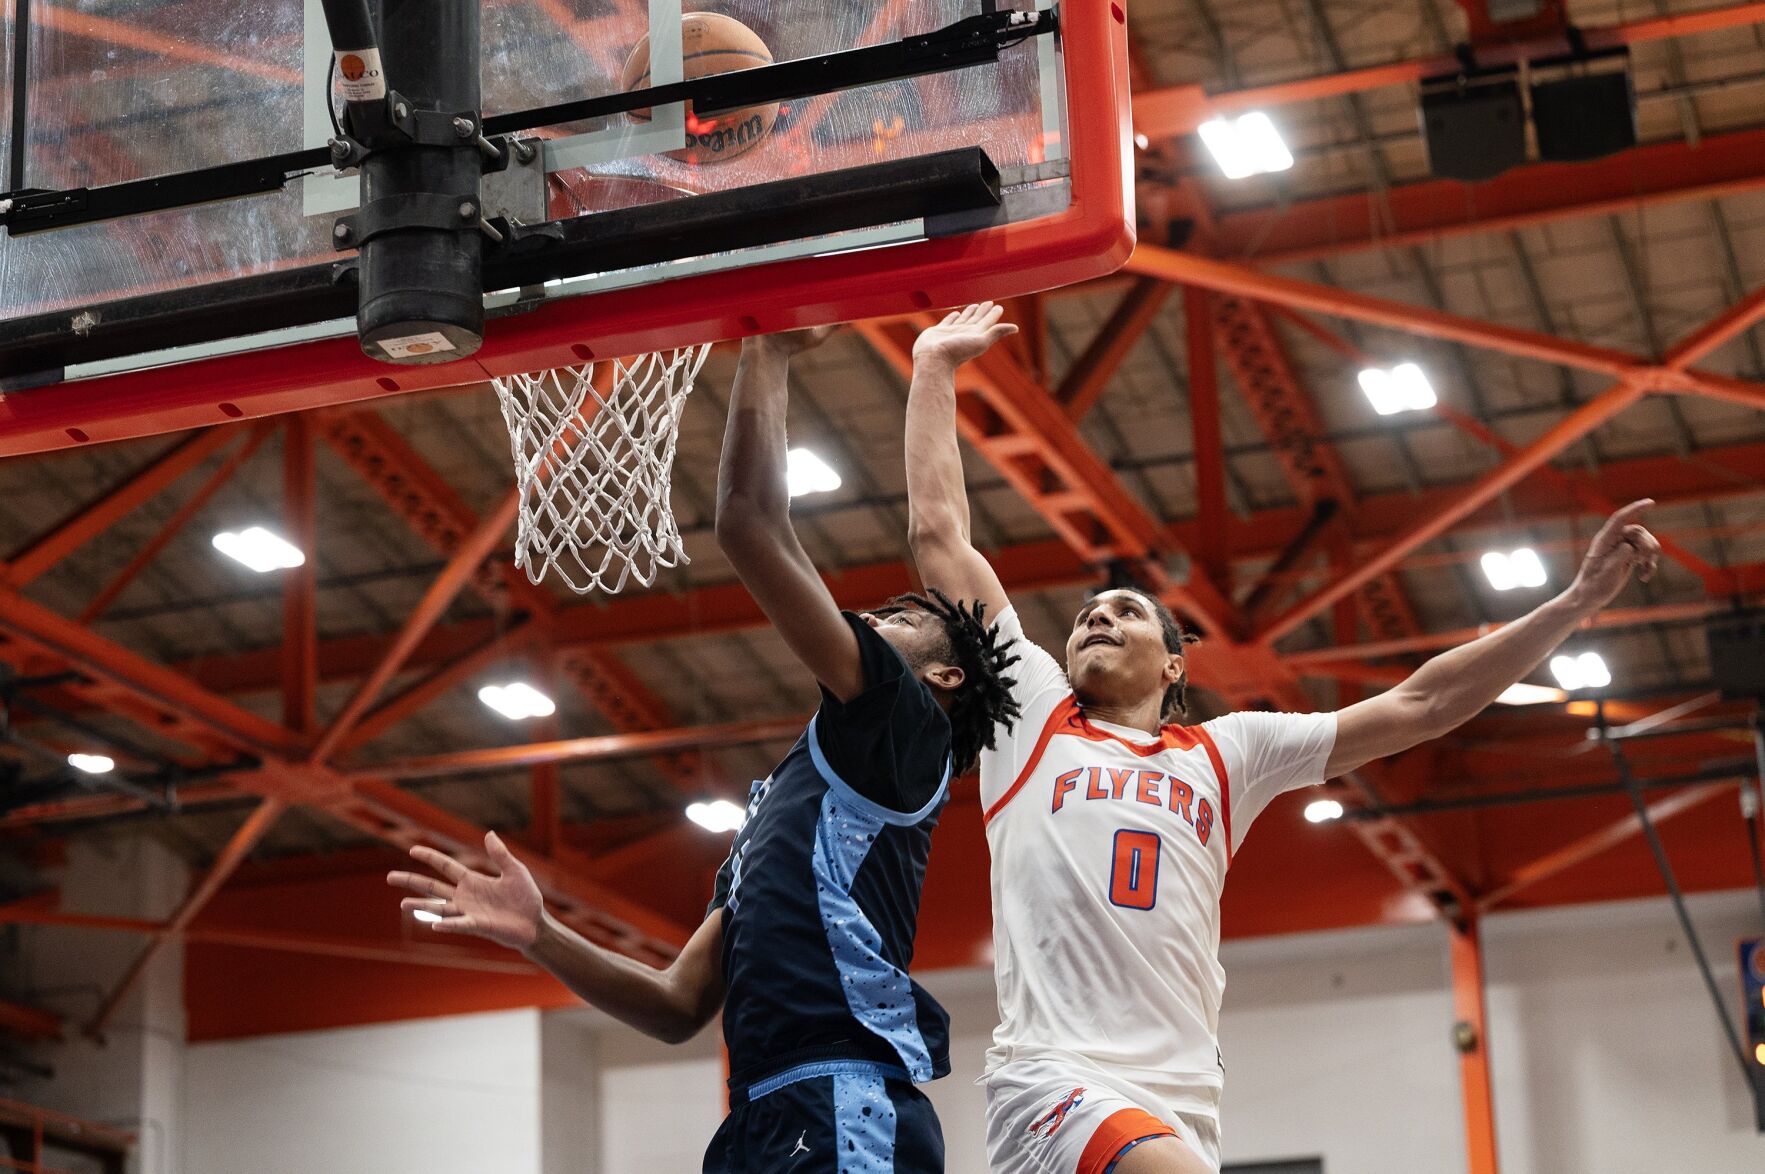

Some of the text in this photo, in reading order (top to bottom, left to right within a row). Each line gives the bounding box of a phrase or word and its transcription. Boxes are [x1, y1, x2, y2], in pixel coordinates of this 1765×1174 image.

[685, 114, 763, 153] Wilso
[1051, 766, 1214, 847] FLYERS
[1108, 828, 1162, 911] 0
